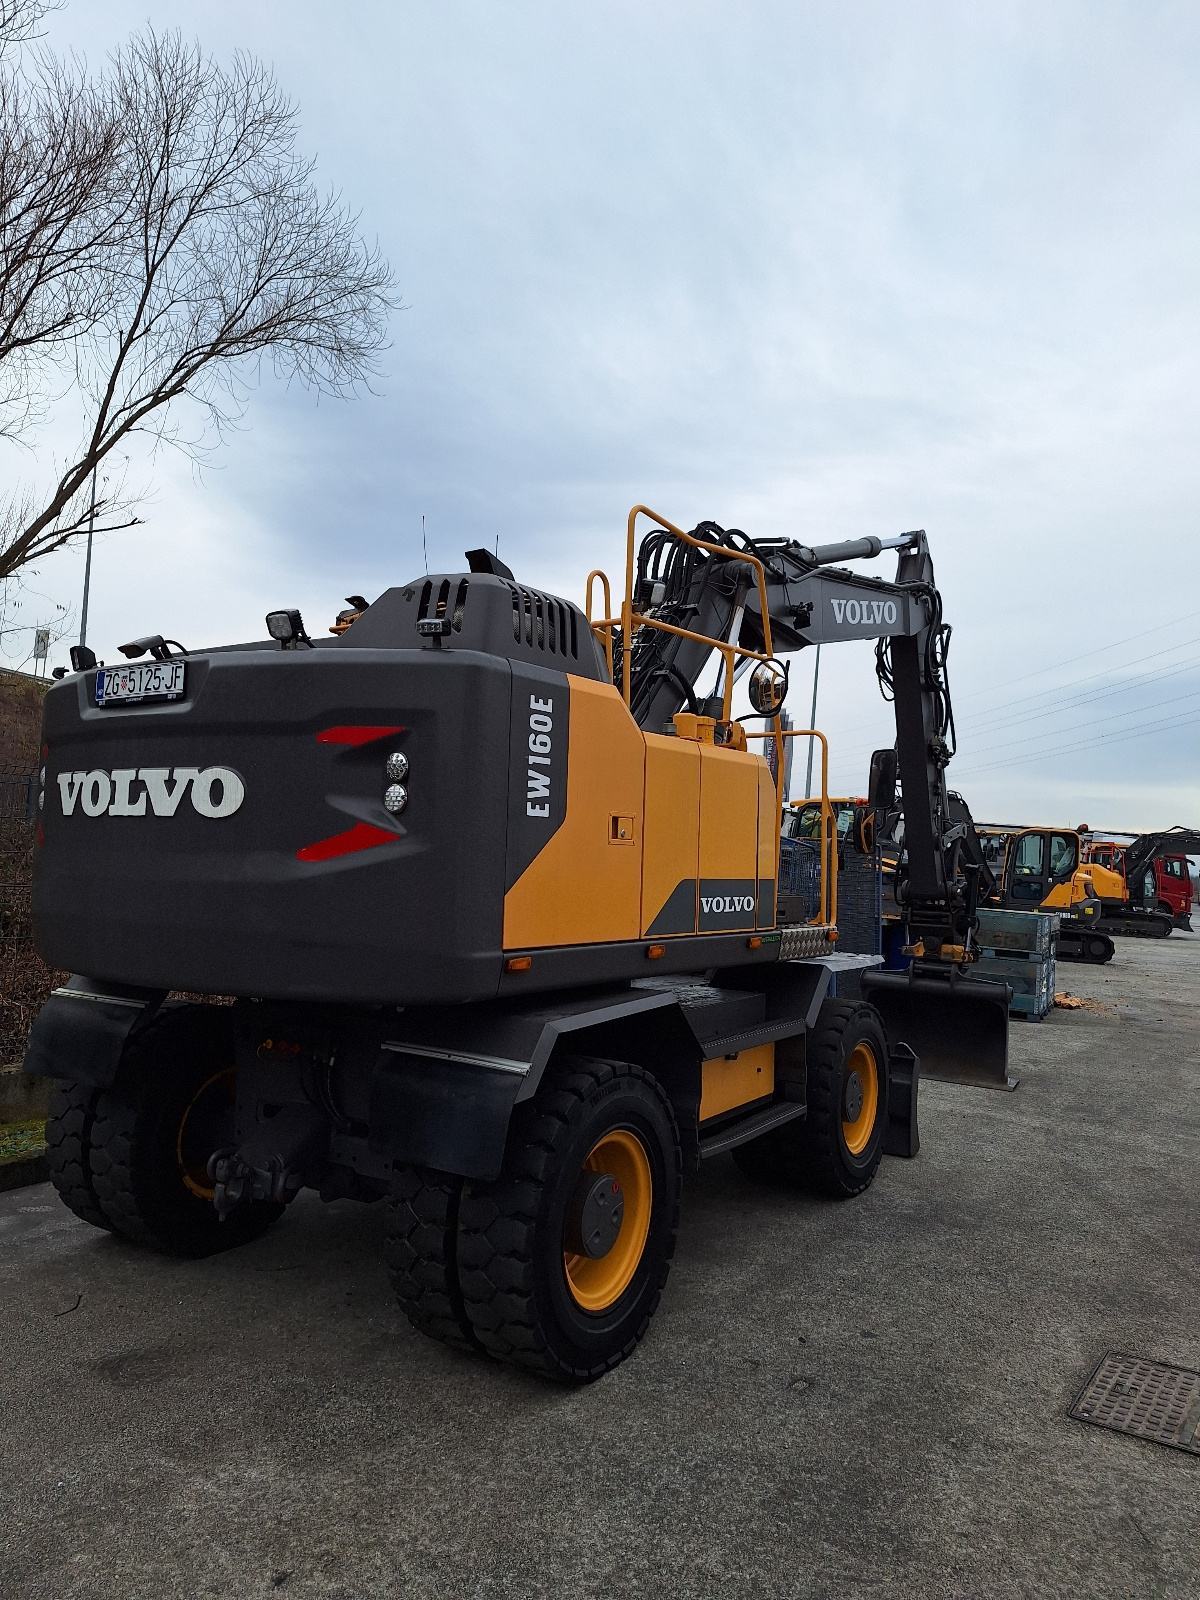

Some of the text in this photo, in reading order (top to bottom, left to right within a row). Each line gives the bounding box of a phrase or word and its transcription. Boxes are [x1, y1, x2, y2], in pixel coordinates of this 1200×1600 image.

[830, 599, 897, 625] VOLVO
[526, 694, 553, 817] EW160E
[56, 767, 246, 818] VOLVO
[700, 896, 755, 913] VOLVO
